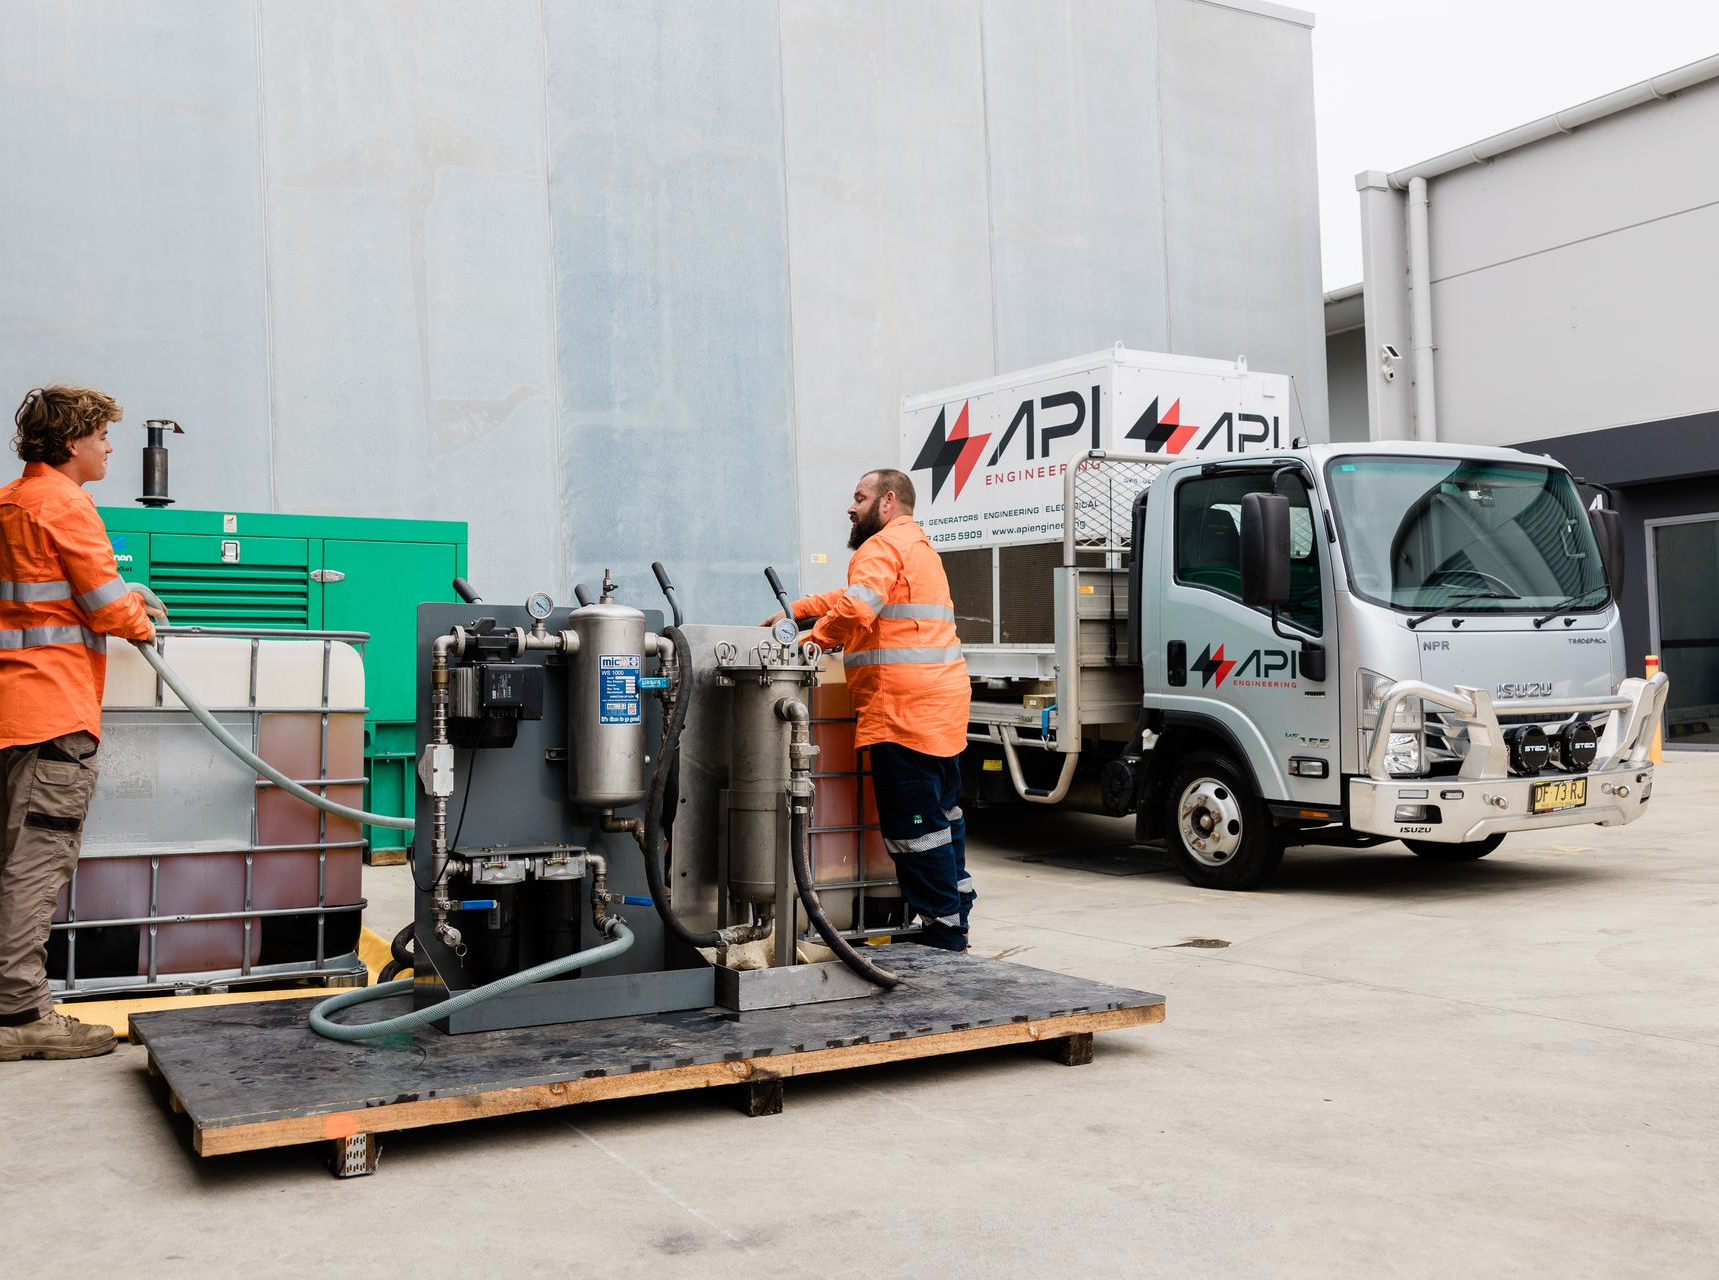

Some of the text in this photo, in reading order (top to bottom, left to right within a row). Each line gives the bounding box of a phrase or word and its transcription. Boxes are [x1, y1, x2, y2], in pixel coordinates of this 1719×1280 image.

[986, 384, 1100, 467] API
[1196, 411, 1279, 453] API
[985, 460, 1101, 486] ENGINEERNG
[928, 513, 979, 526] GENERATORS
[983, 506, 1040, 520] ENGINEERING
[1045, 500, 1099, 513] ELECRICAL
[932, 532, 957, 542] 4325
[958, 530, 983, 540] 5909
[113, 554, 133, 562] nan
[1423, 640, 1450, 651] NPR
[1234, 649, 1297, 680] API
[1233, 679, 1298, 689] ENGINEERING
[1496, 682, 1552, 699] ISUZU
